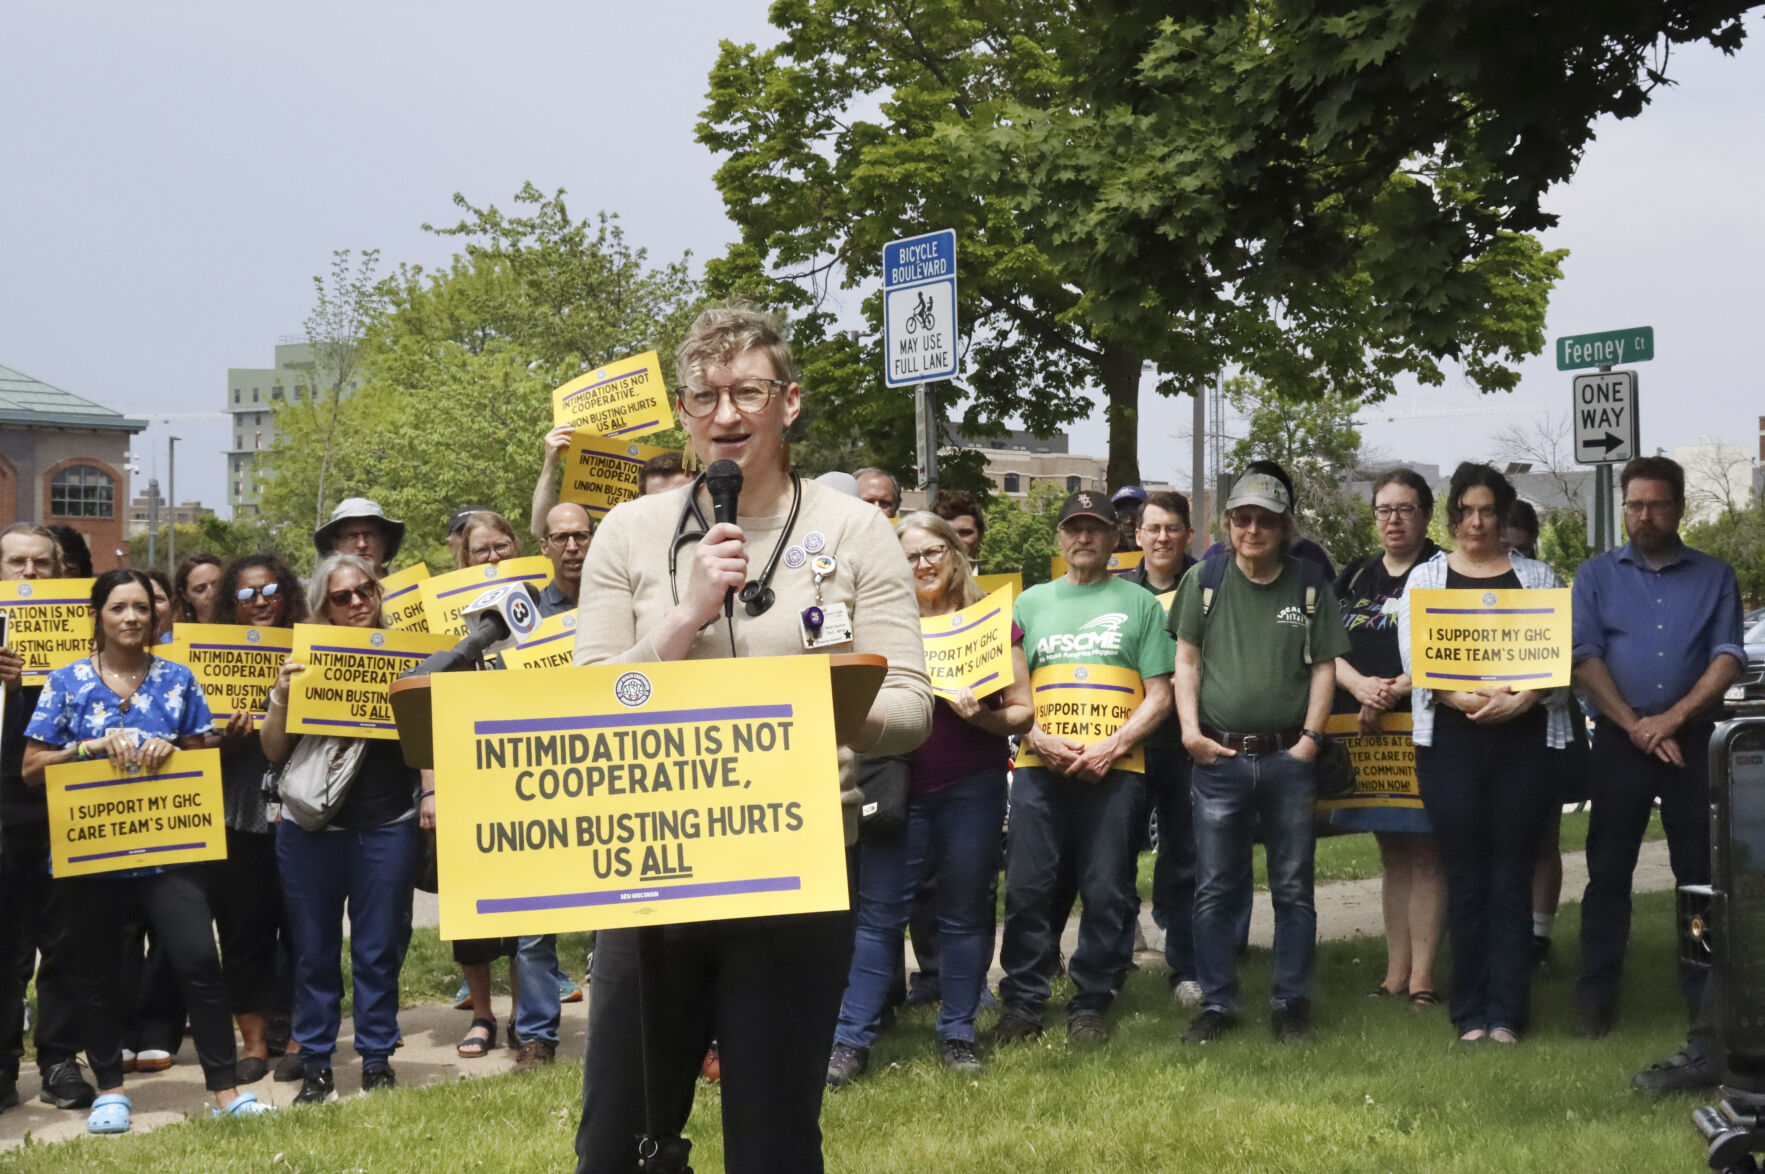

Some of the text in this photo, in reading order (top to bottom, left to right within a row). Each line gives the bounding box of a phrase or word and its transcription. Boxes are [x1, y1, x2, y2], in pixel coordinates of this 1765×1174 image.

[900, 241, 938, 264] BICYCLE
[892, 258, 947, 284] BOULEVARD
[900, 333, 942, 356] MAY USE
[1564, 337, 1646, 364] Feeney Ct
[895, 351, 948, 375] FULL LANE
[562, 373, 650, 410] INTIMIDATION IS NOT
[1582, 382, 1624, 404] ONE
[569, 397, 656, 428] NION BUSTING HURTS
[1582, 407, 1624, 429] WAY
[597, 416, 626, 432] US ALL
[574, 480, 603, 493] UNION
[590, 467, 638, 485] COOPERA
[51, 606, 62, 618] IS
[66, 605, 92, 618] NOT
[965, 640, 978, 656] MY
[980, 628, 998, 648] GHC
[1037, 630, 1122, 656] AFSCME
[1429, 628, 1552, 642] I SUPPORT MY GHC
[29, 653, 50, 666] ALL
[189, 650, 285, 666] INTIMIDATION IS
[310, 652, 396, 671] INTIMIDATION
[399, 658, 411, 671] IS
[976, 643, 1003, 668] UNION
[1426, 646, 1560, 662] CARE TEAM'S UNION
[204, 664, 280, 678] COOPERATI
[232, 698, 246, 710] US
[305, 686, 388, 704] UNION BUSTIN
[350, 704, 390, 719] US ALL
[1040, 702, 1087, 718] SUPPORT
[1090, 704, 1108, 718] MY
[476, 722, 794, 770] INTIMIDATION IS NOT
[1374, 751, 1400, 761] CARE
[1402, 752, 1414, 761] FO
[516, 756, 752, 801] COOPERATIVE,
[1360, 780, 1385, 790] NION
[70, 793, 202, 820] I SUPPORT MY GHC
[66, 813, 212, 842] CARE TEAM'S UNION
[476, 802, 804, 854] UNION BUSTING HURTS
[593, 843, 693, 879] US ALL
